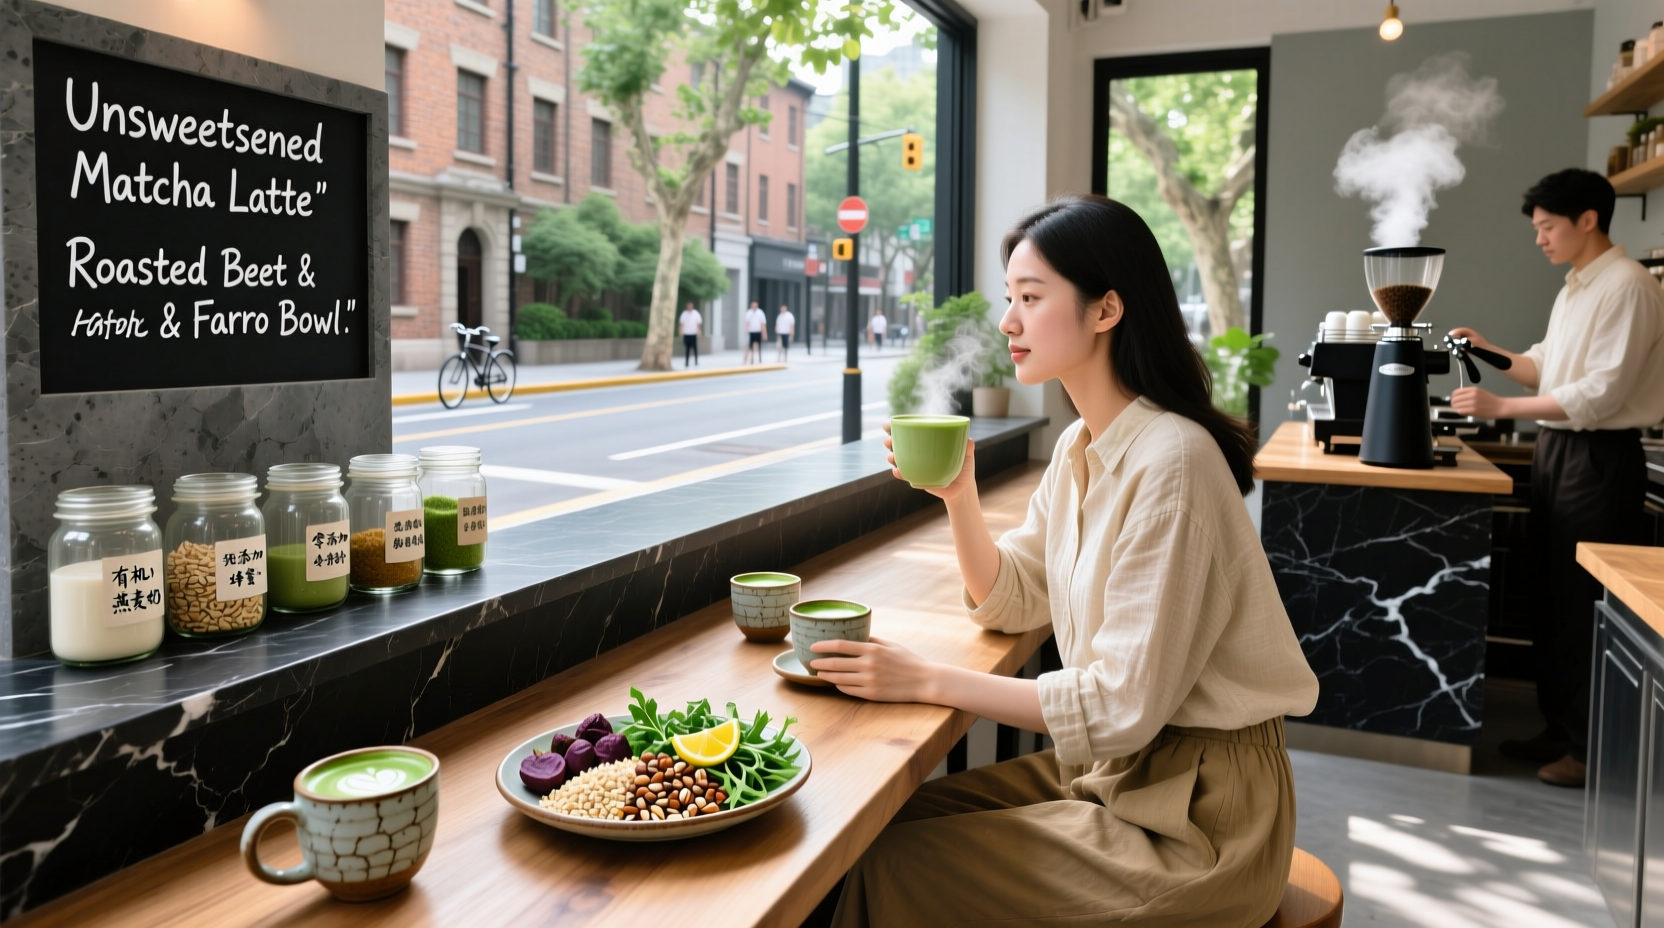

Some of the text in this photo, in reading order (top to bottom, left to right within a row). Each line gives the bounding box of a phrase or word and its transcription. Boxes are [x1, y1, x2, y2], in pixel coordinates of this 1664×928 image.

[65, 77, 324, 164] Unsweetsened
[70, 150, 327, 217] Matcha Latte"
[65, 236, 316, 289] Roasted Beet &
[159, 301, 181, 339] &
[193, 298, 269, 340] Farro
[278, 298, 356, 337] Bowl."
